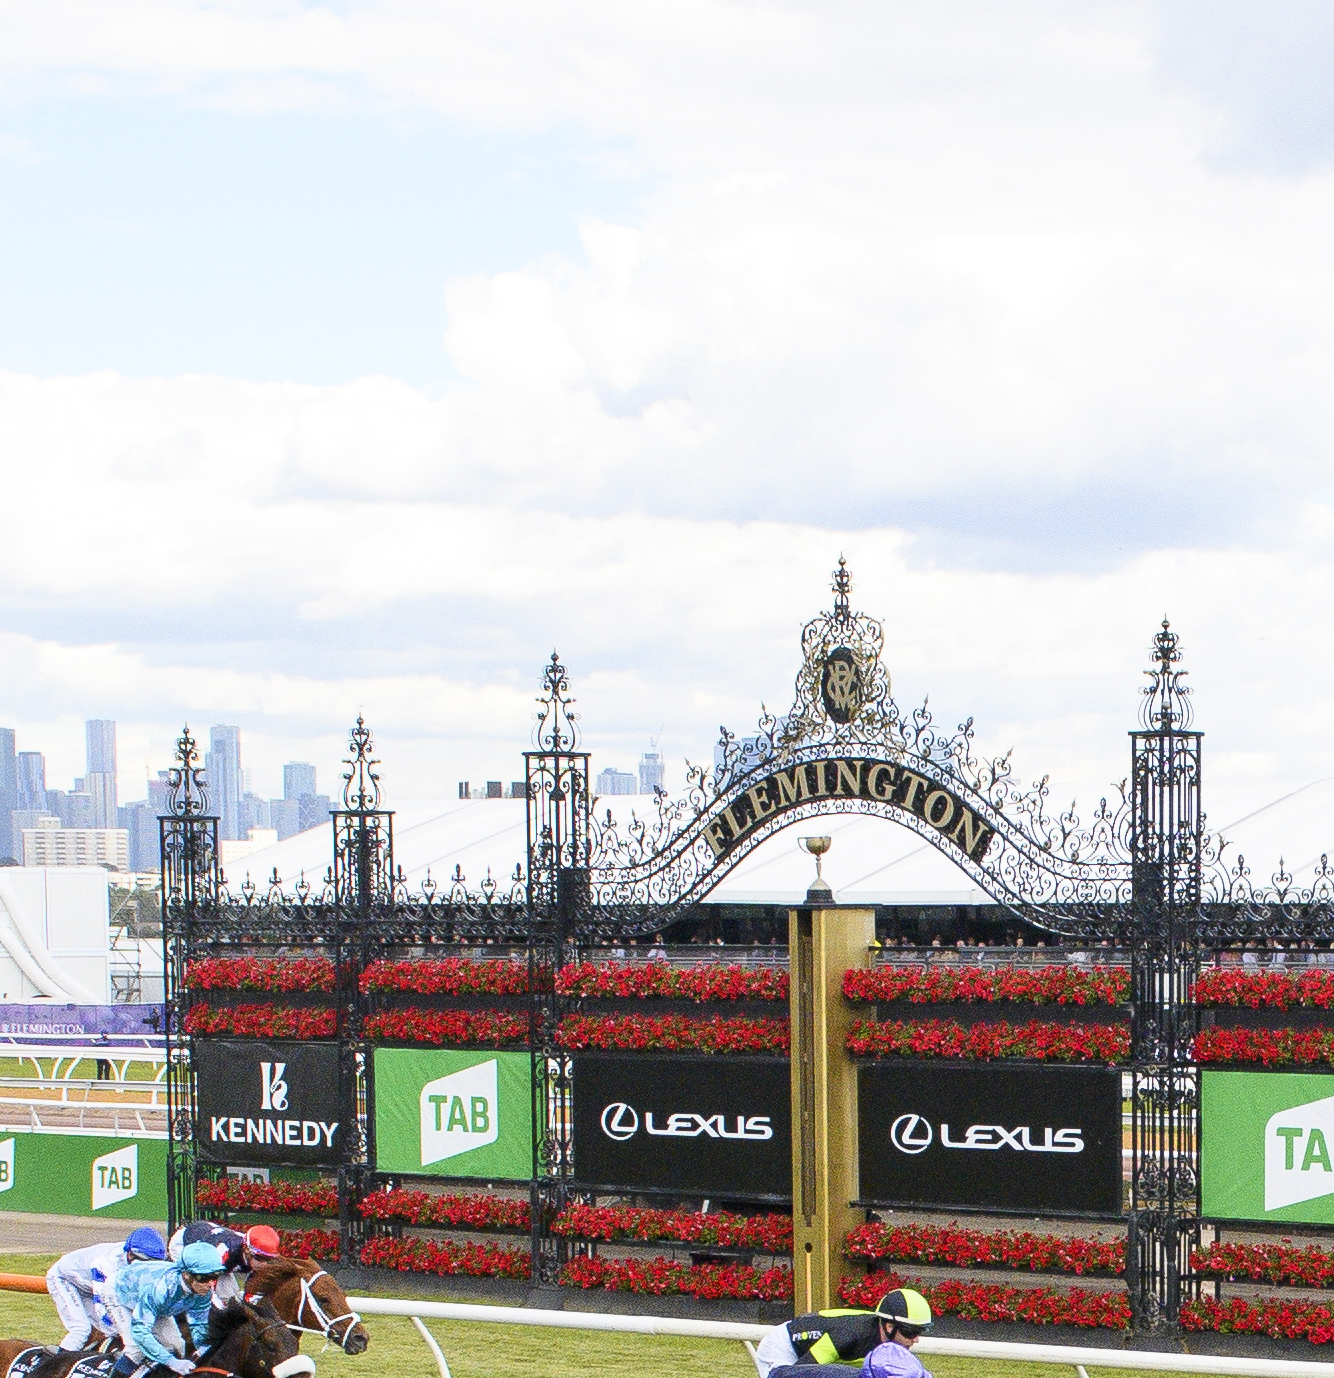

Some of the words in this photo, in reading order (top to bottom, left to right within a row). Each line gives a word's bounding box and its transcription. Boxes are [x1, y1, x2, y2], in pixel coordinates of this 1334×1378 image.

[701, 759, 990, 857] FLEMINGTON
[428, 1093, 491, 1136] TAB
[644, 1111, 773, 1141] LEXUS
[211, 1116, 339, 1148] KENNEDY
[941, 1122, 1085, 1154] LEXUS
[97, 1164, 133, 1191] TAB
